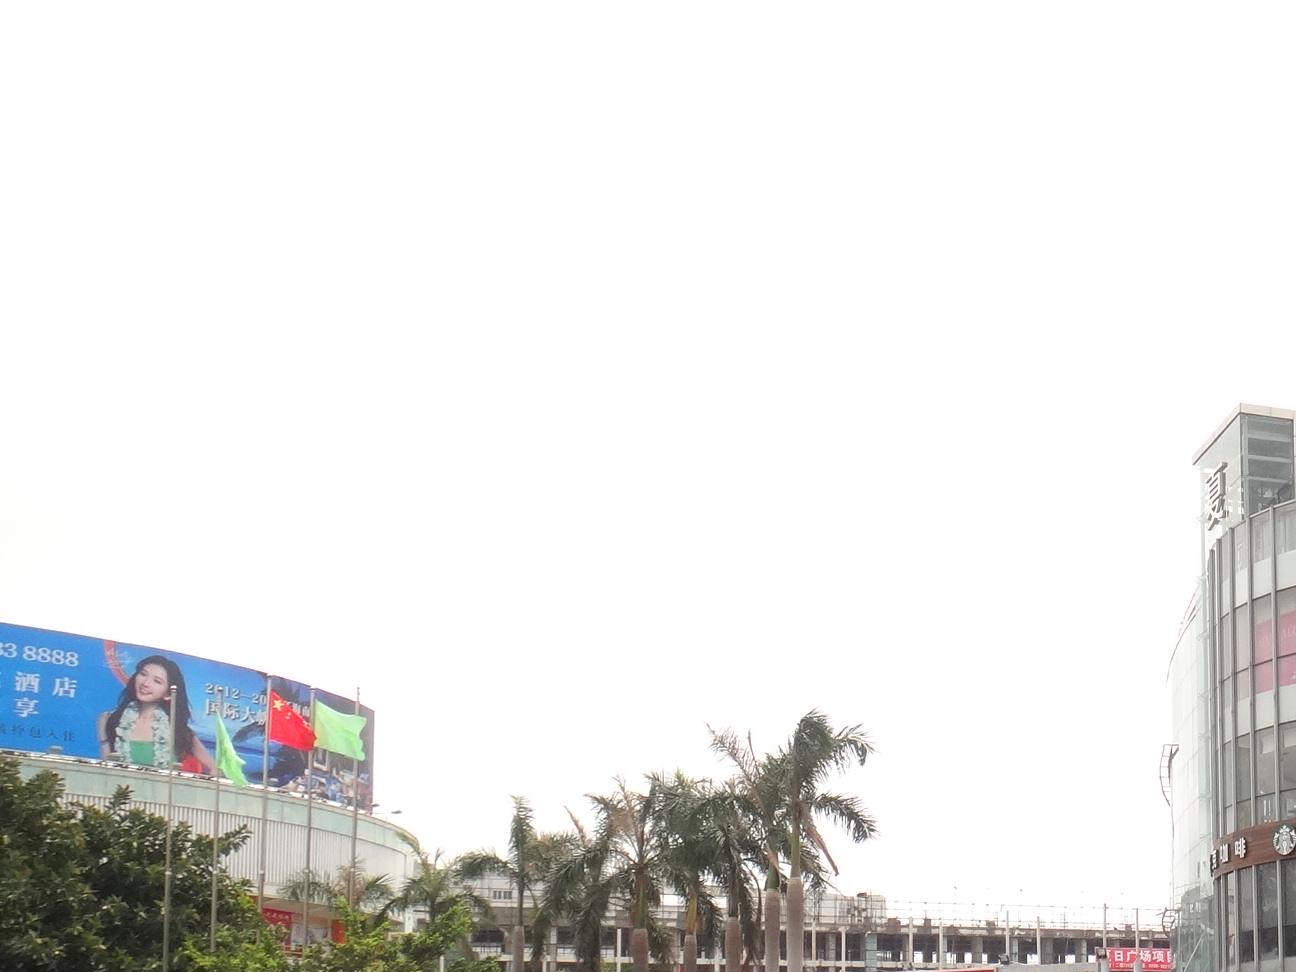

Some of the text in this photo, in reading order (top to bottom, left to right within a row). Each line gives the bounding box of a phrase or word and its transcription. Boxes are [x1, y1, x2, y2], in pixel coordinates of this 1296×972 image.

[0, 642, 79, 667] 3 8888
[15, 672, 78, 698] 酒店
